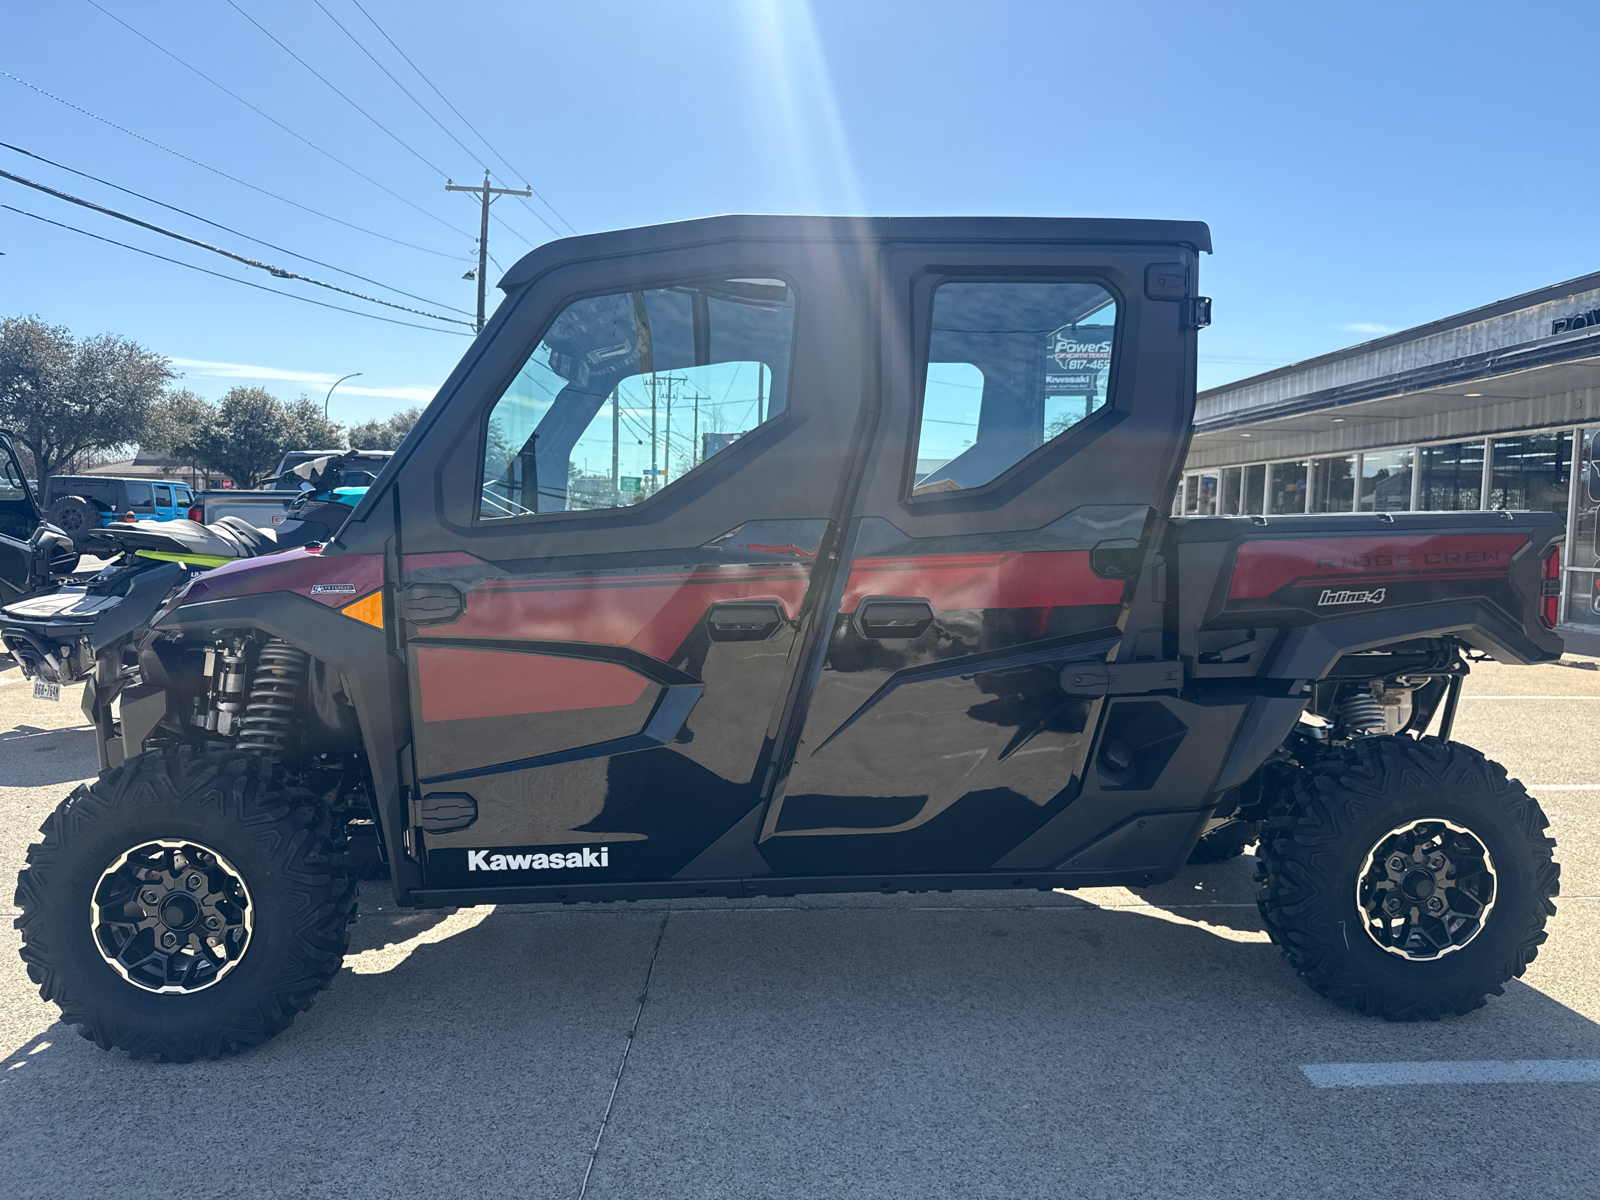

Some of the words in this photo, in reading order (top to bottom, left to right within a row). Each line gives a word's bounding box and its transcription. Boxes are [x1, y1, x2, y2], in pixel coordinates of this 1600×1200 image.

[1055, 341, 1112, 353] PowerS
[1316, 554, 1412, 569] RIDGE
[1424, 550, 1500, 565] CREW
[1317, 588, 1386, 606] Inline-4
[468, 847, 608, 871] Kawasaki
